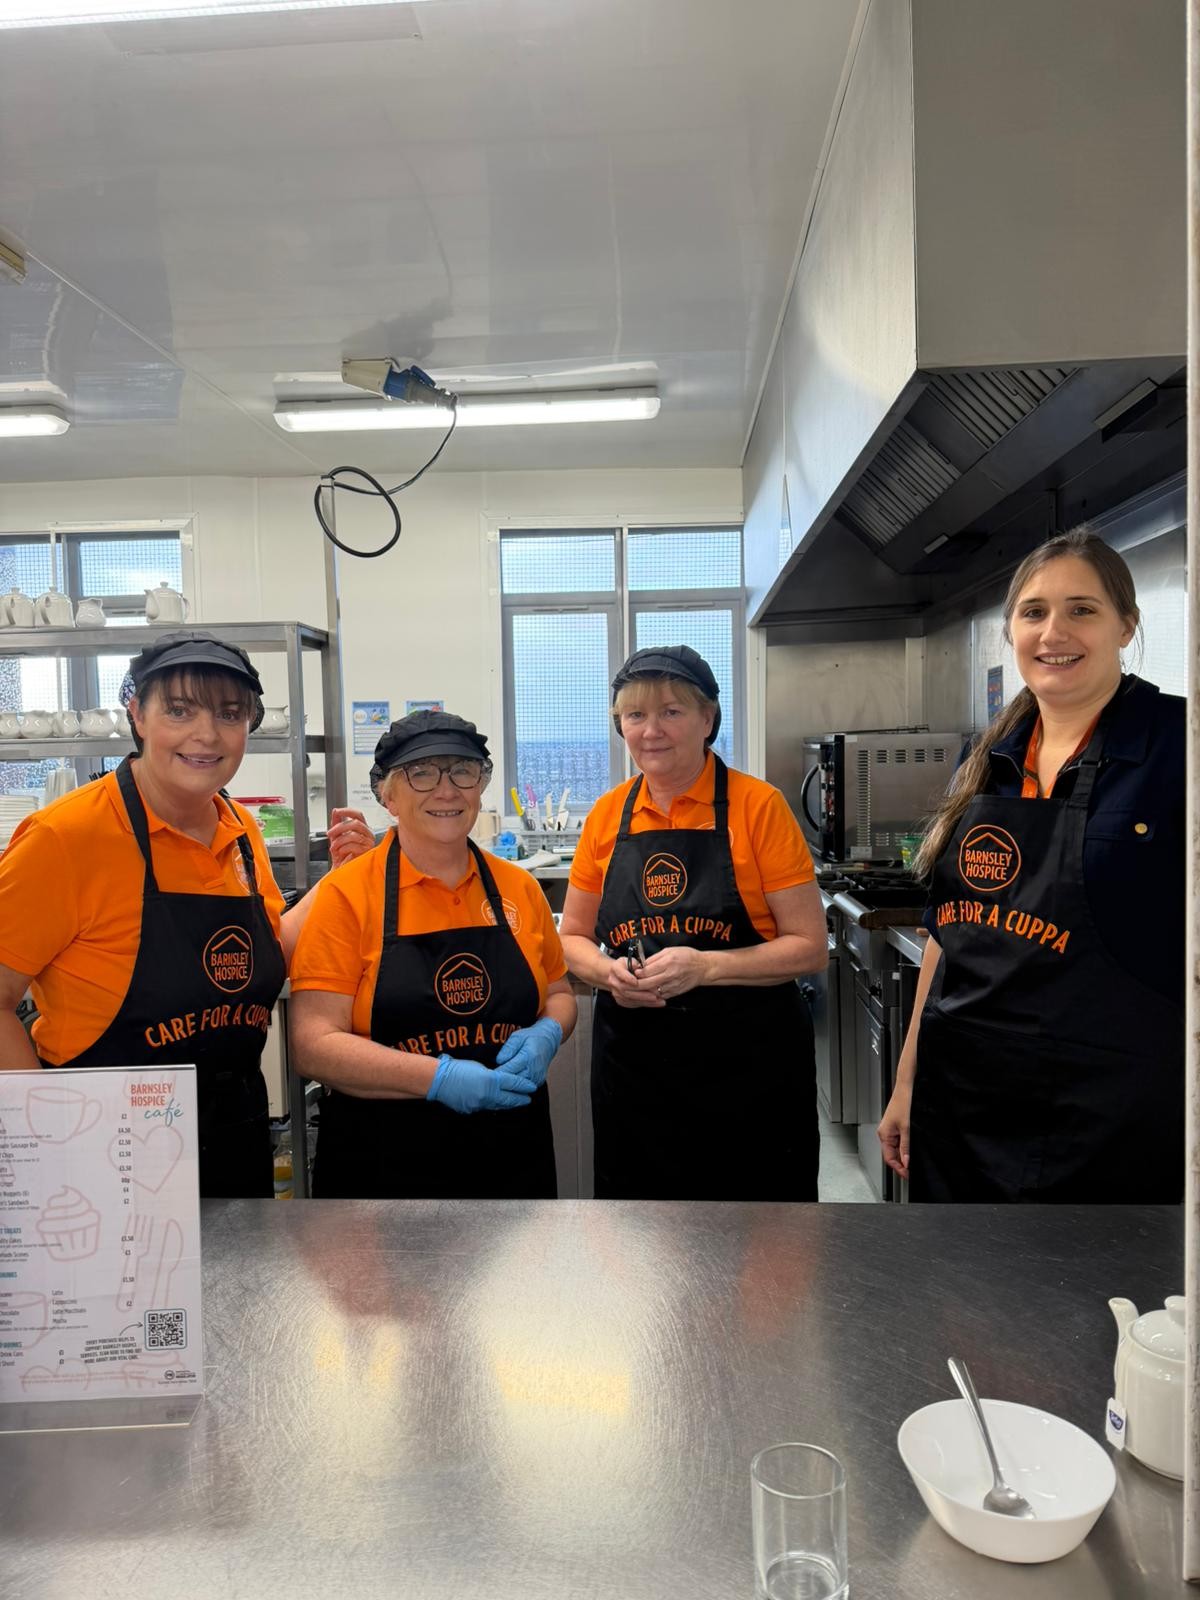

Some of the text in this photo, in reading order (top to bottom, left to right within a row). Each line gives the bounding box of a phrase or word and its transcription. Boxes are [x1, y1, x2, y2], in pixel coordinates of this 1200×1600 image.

[965, 849, 1012, 867] BARNSLEY
[646, 873, 681, 886] BARNSLEY
[966, 864, 1007, 881] HOSPICE
[648, 885, 678, 898] HOSPICE
[609, 920, 637, 947] CARE
[641, 915, 665, 936] FOR
[670, 915, 680, 934] A
[937, 900, 1070, 954] CARE FOR A CUPPA
[211, 952, 249, 967] BARNSLEY
[214, 966, 248, 981] HOSPICE
[442, 975, 484, 993] BARNSLEY
[446, 988, 484, 1006] HOSPICE
[144, 1012, 197, 1048] CARE
[201, 1004, 231, 1031] FOR
[233, 1003, 244, 1026] A
[392, 1034, 432, 1055] ARE
[435, 1026, 470, 1051] FOR
[475, 1023, 486, 1045] A
[130, 1082, 173, 1094] BARNSLEY
[131, 1095, 165, 1107] HOSPICE
[143, 1097, 184, 1127] café
